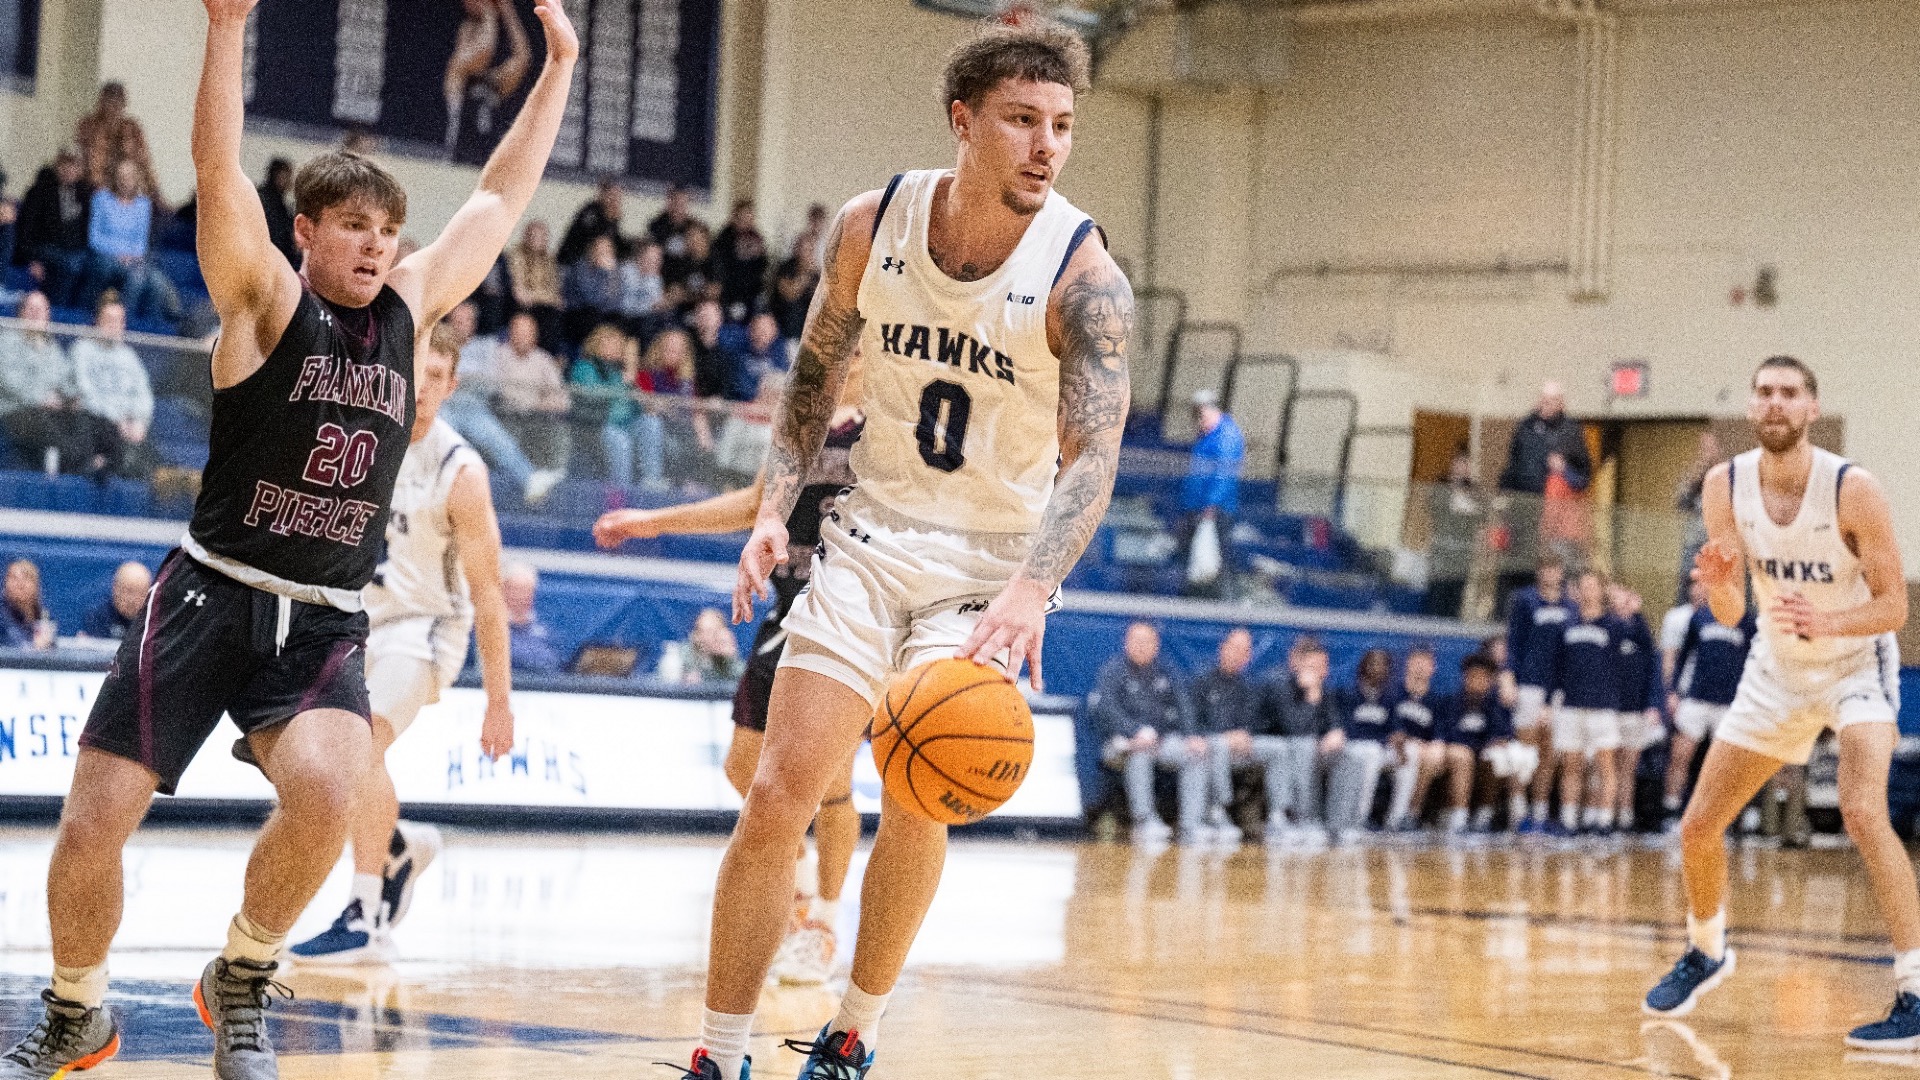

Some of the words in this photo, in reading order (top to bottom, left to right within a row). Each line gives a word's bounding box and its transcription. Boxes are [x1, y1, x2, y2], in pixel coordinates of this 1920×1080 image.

[881, 323, 1016, 386] HAWKS
[289, 354, 407, 427] FRANKLIN
[302, 422, 379, 488] 20
[915, 377, 973, 475] 0
[243, 479, 380, 546] PIERCE
